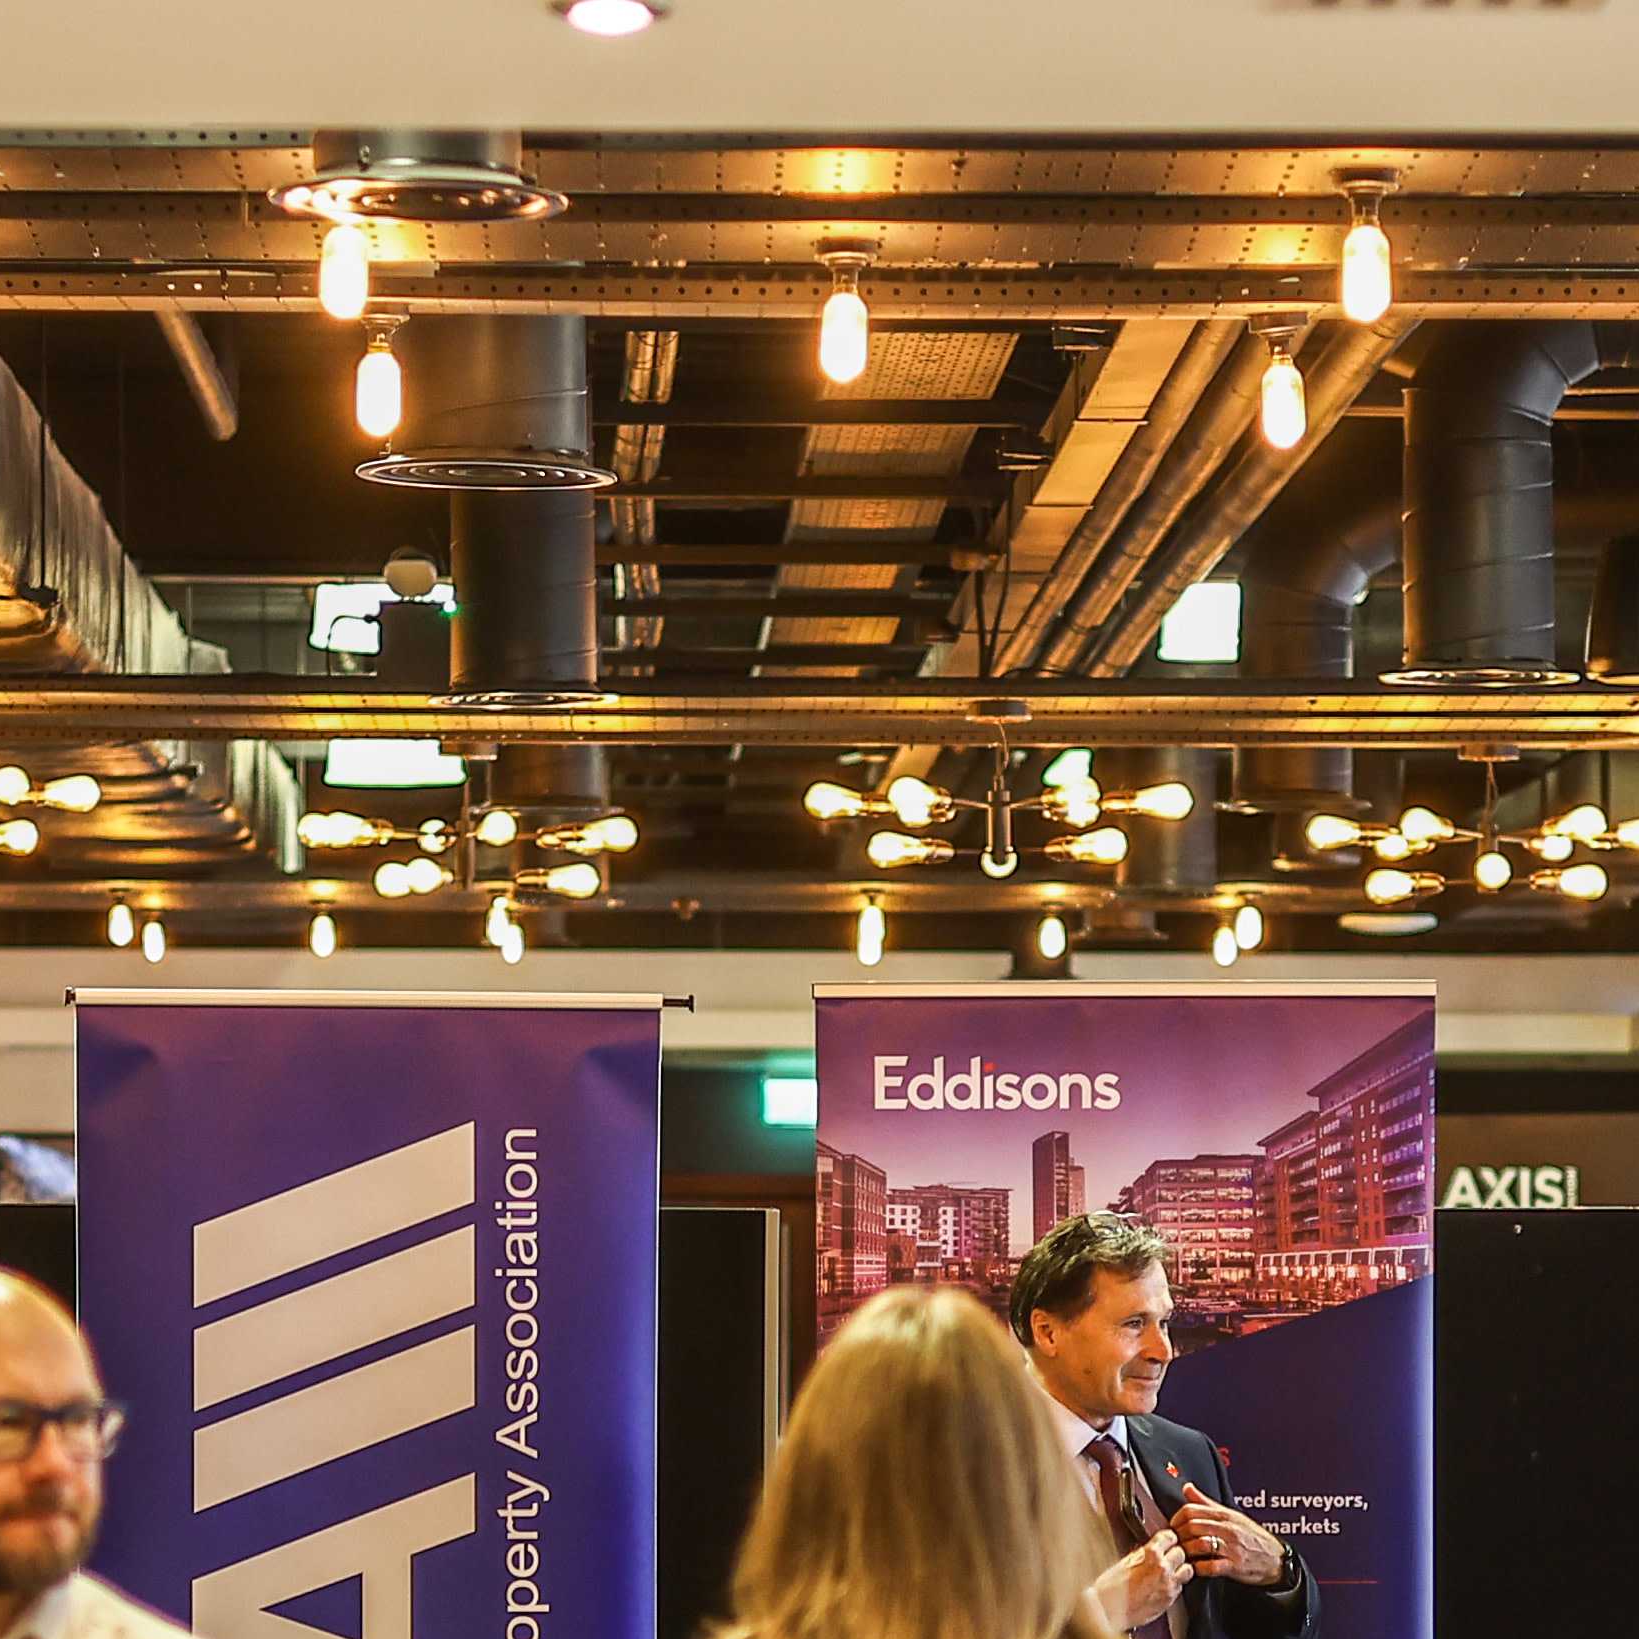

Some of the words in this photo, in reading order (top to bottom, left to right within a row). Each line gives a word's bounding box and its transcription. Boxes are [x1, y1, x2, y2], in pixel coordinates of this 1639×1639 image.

[873, 1054, 1122, 1112] Eddisons
[1442, 1165, 1564, 1209] AXIS
[495, 1127, 539, 1458] Association
[1270, 1494, 1369, 1513] surveyors,
